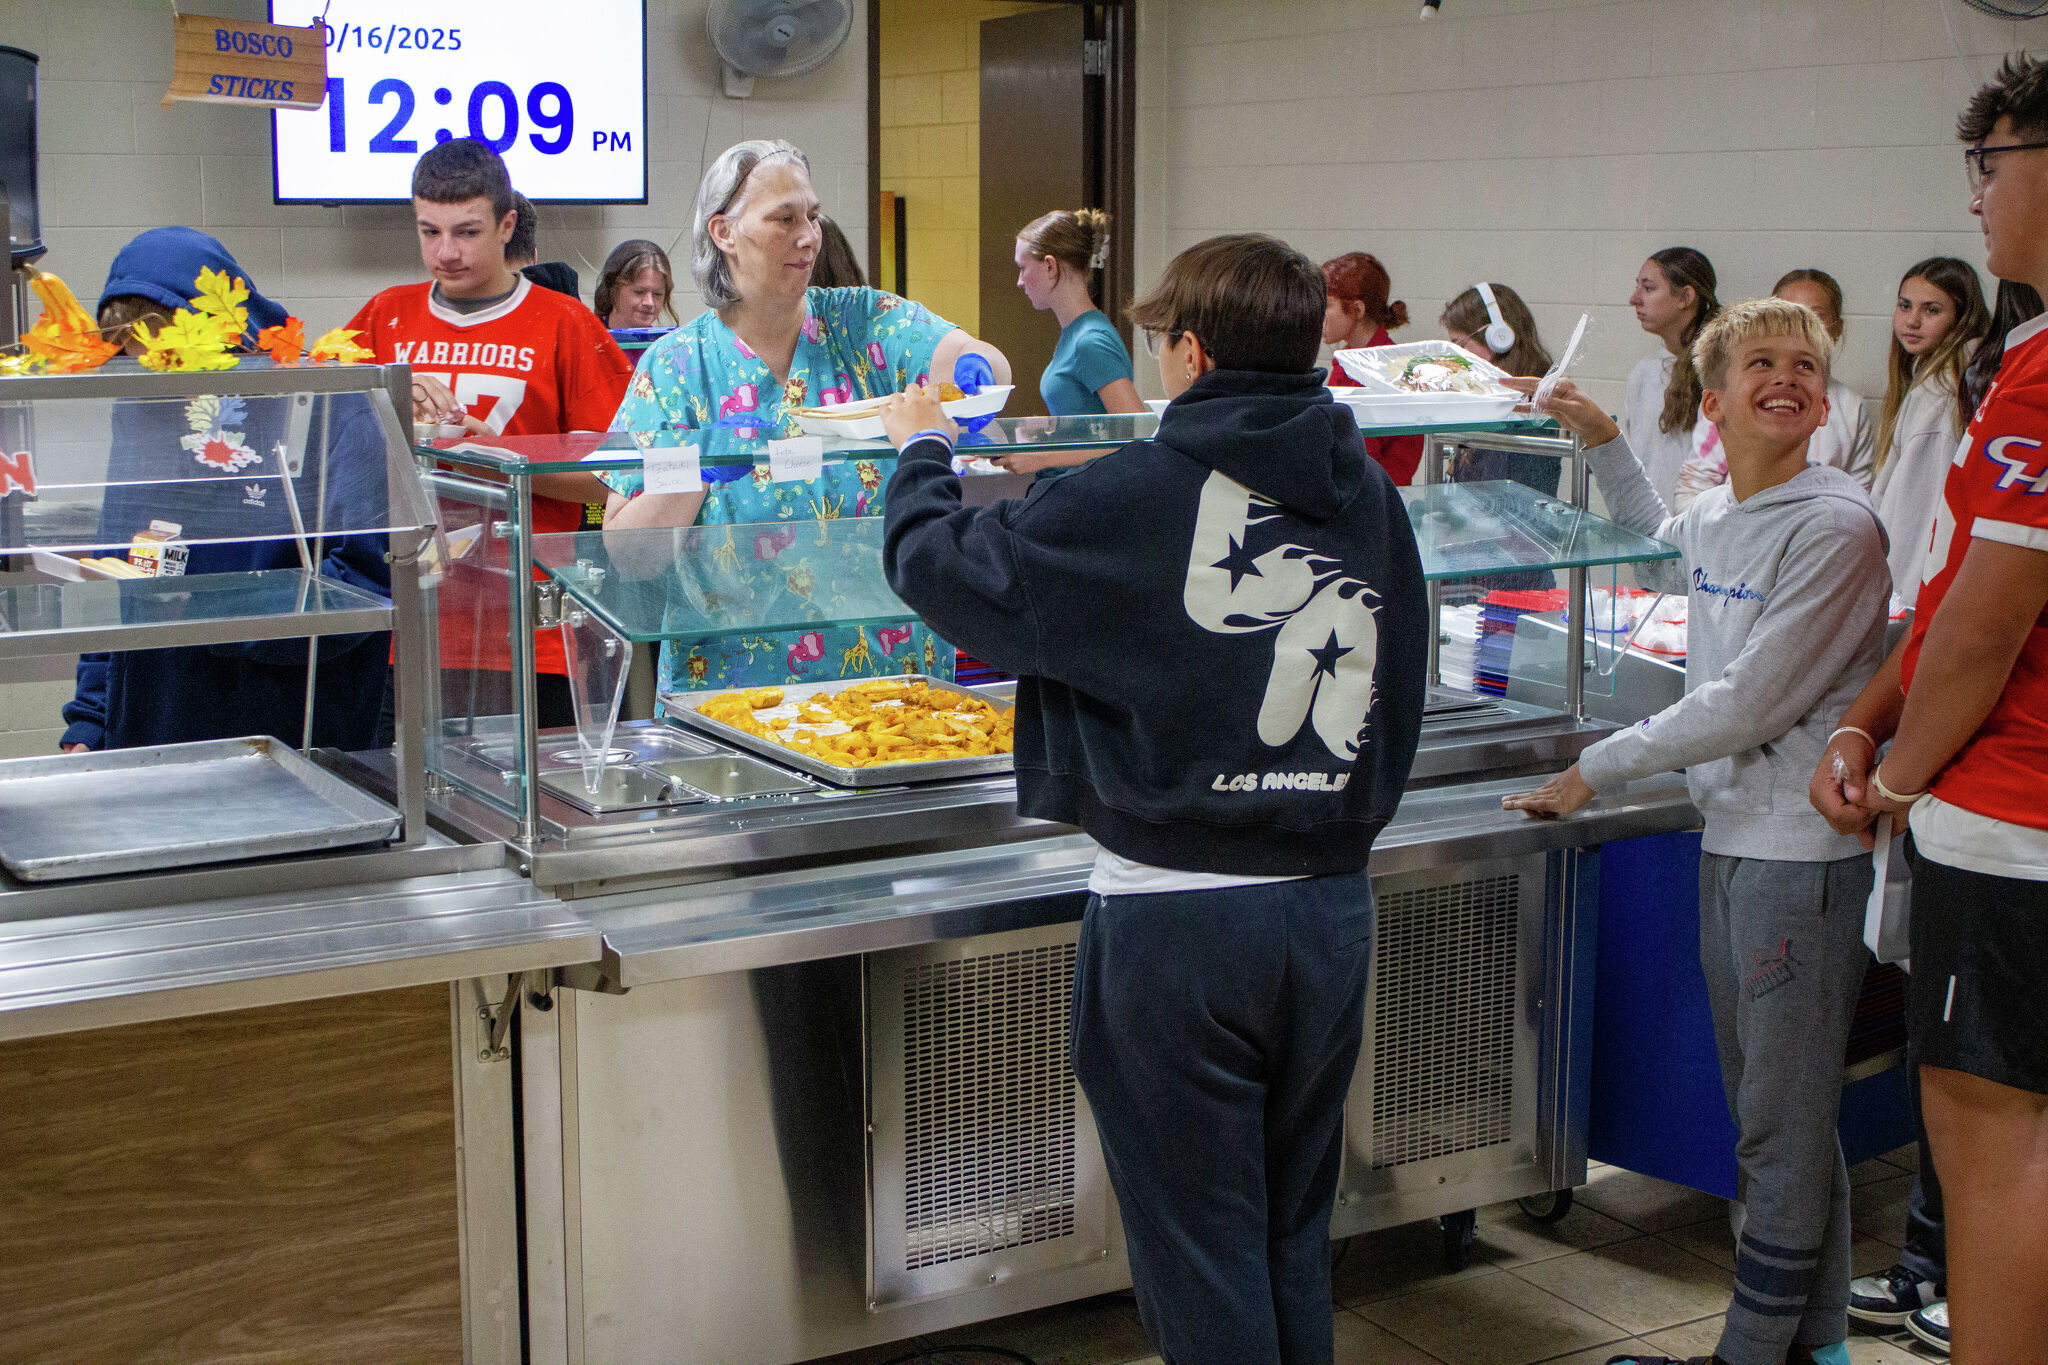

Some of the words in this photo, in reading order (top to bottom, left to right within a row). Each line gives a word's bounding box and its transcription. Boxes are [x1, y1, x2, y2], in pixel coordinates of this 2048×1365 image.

[215, 28, 293, 58] BOSCO
[324, 22, 462, 54] 0/16/2025
[207, 73, 295, 101] STICKS
[326, 77, 575, 155] 12:09
[592, 131, 632, 152] PM
[394, 341, 535, 372] WARRIORS
[411, 371, 528, 437] 7
[242, 498, 266, 508] adidas
[164, 548, 188, 563] MILK
[1692, 566, 1767, 608] Champion
[1211, 773, 1258, 792] LOS
[1261, 772, 1351, 792] ANGELE
